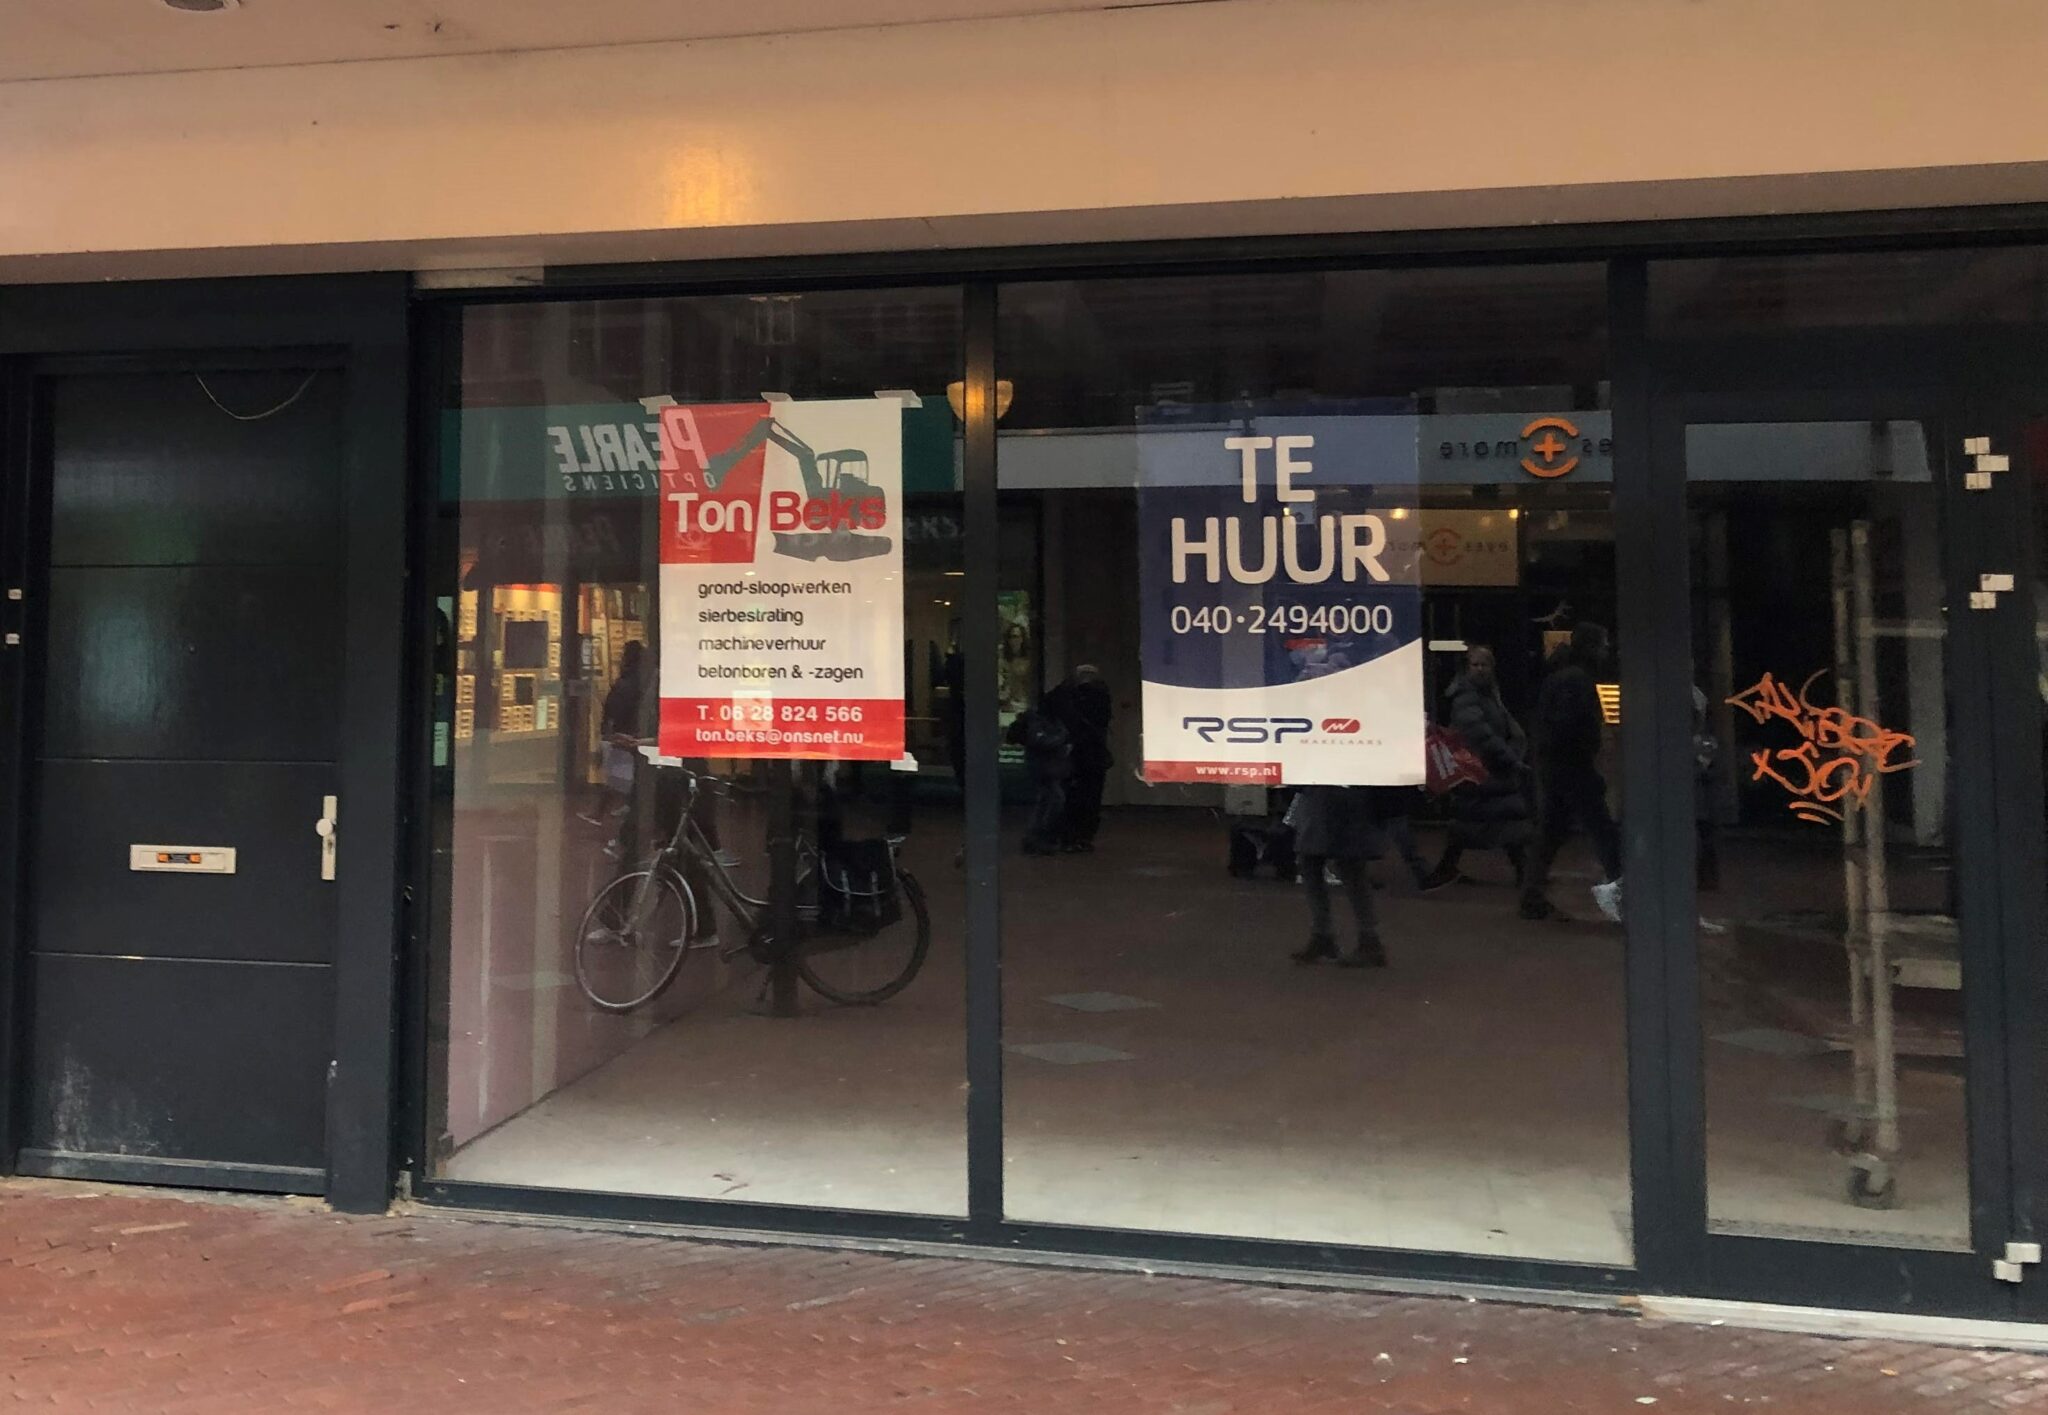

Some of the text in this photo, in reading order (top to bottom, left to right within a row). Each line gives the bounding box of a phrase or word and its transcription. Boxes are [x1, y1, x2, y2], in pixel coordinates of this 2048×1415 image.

[1224, 435, 1316, 503] TE
[667, 492, 753, 533] Ton
[769, 488, 887, 531] Beks
[1171, 514, 1390, 584] HUUR
[697, 580, 852, 598] grond-sloopwerken
[698, 608, 804, 626] sierbestrating
[698, 636, 826, 651] machineverhuur
[698, 664, 864, 683] betonboren & -zagen
[696, 705, 864, 723] T. 06 28 824 566
[695, 727, 865, 746] ton.beks@onsnet.nu
[1183, 716, 1313, 744] RSP
[1195, 764, 1278, 777] www.rsp.nl
